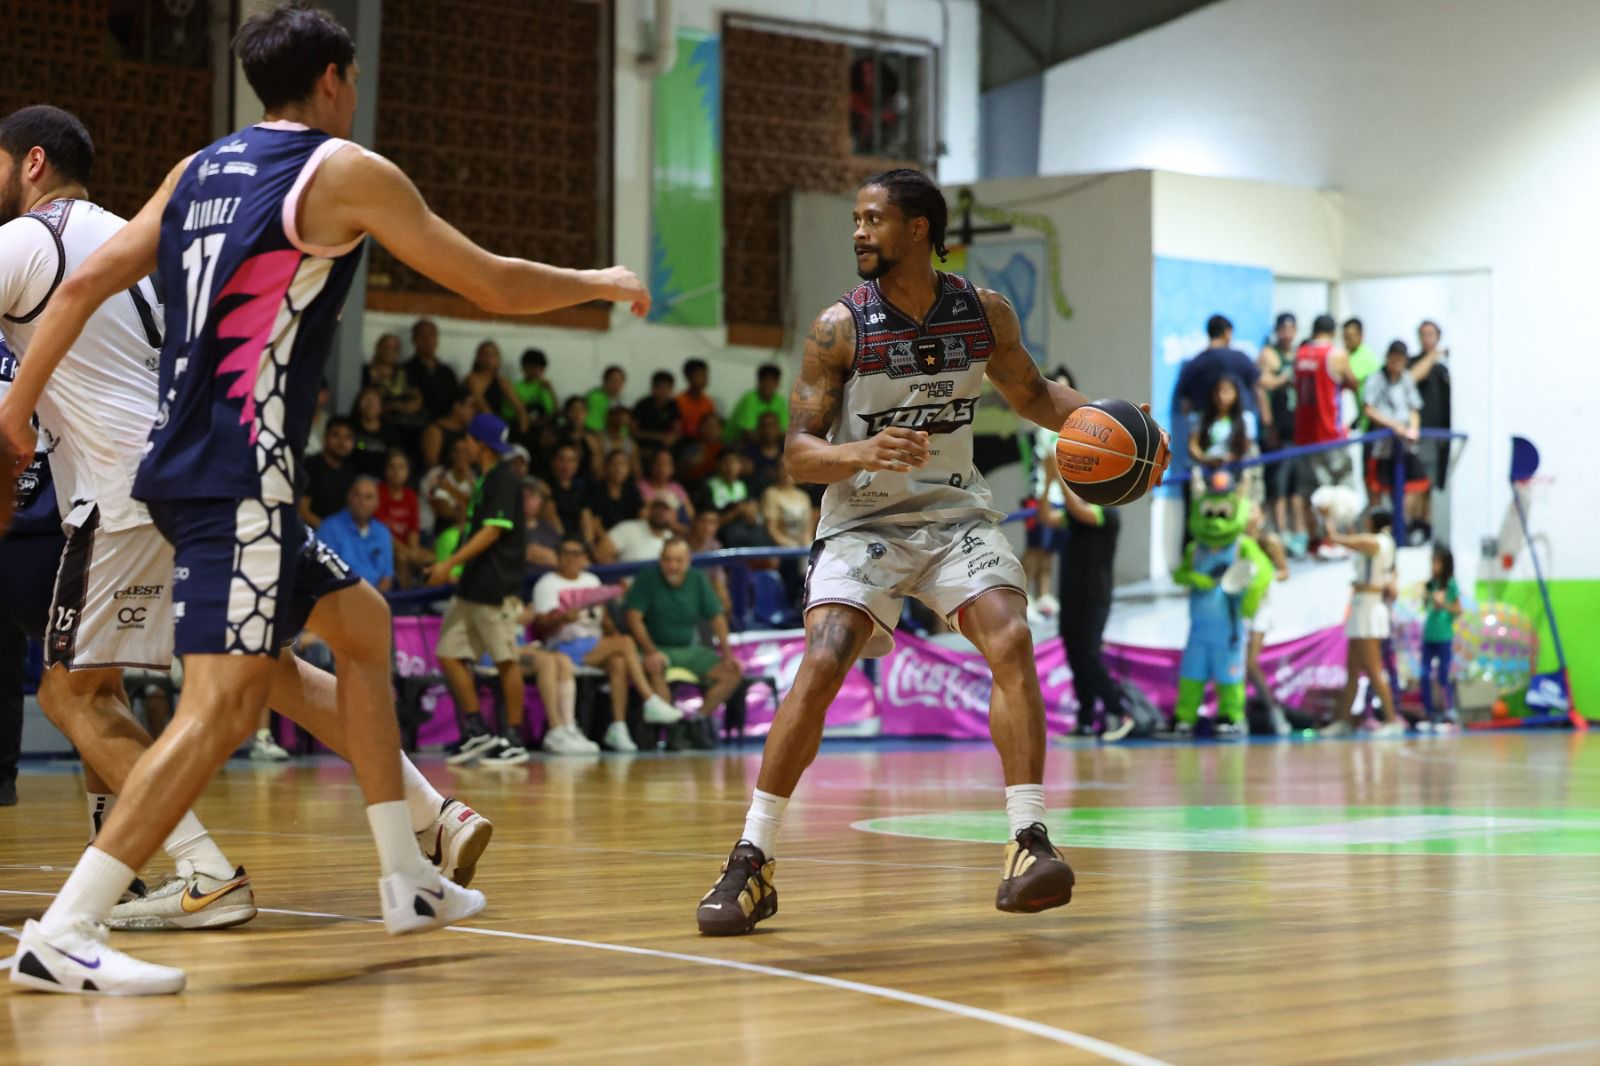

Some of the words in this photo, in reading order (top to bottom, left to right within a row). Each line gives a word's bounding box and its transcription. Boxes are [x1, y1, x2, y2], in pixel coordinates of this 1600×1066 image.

[182, 232, 226, 343] 17
[910, 380, 954, 393] POWER
[55, 605, 77, 632] 15
[117, 606, 147, 624] OC
